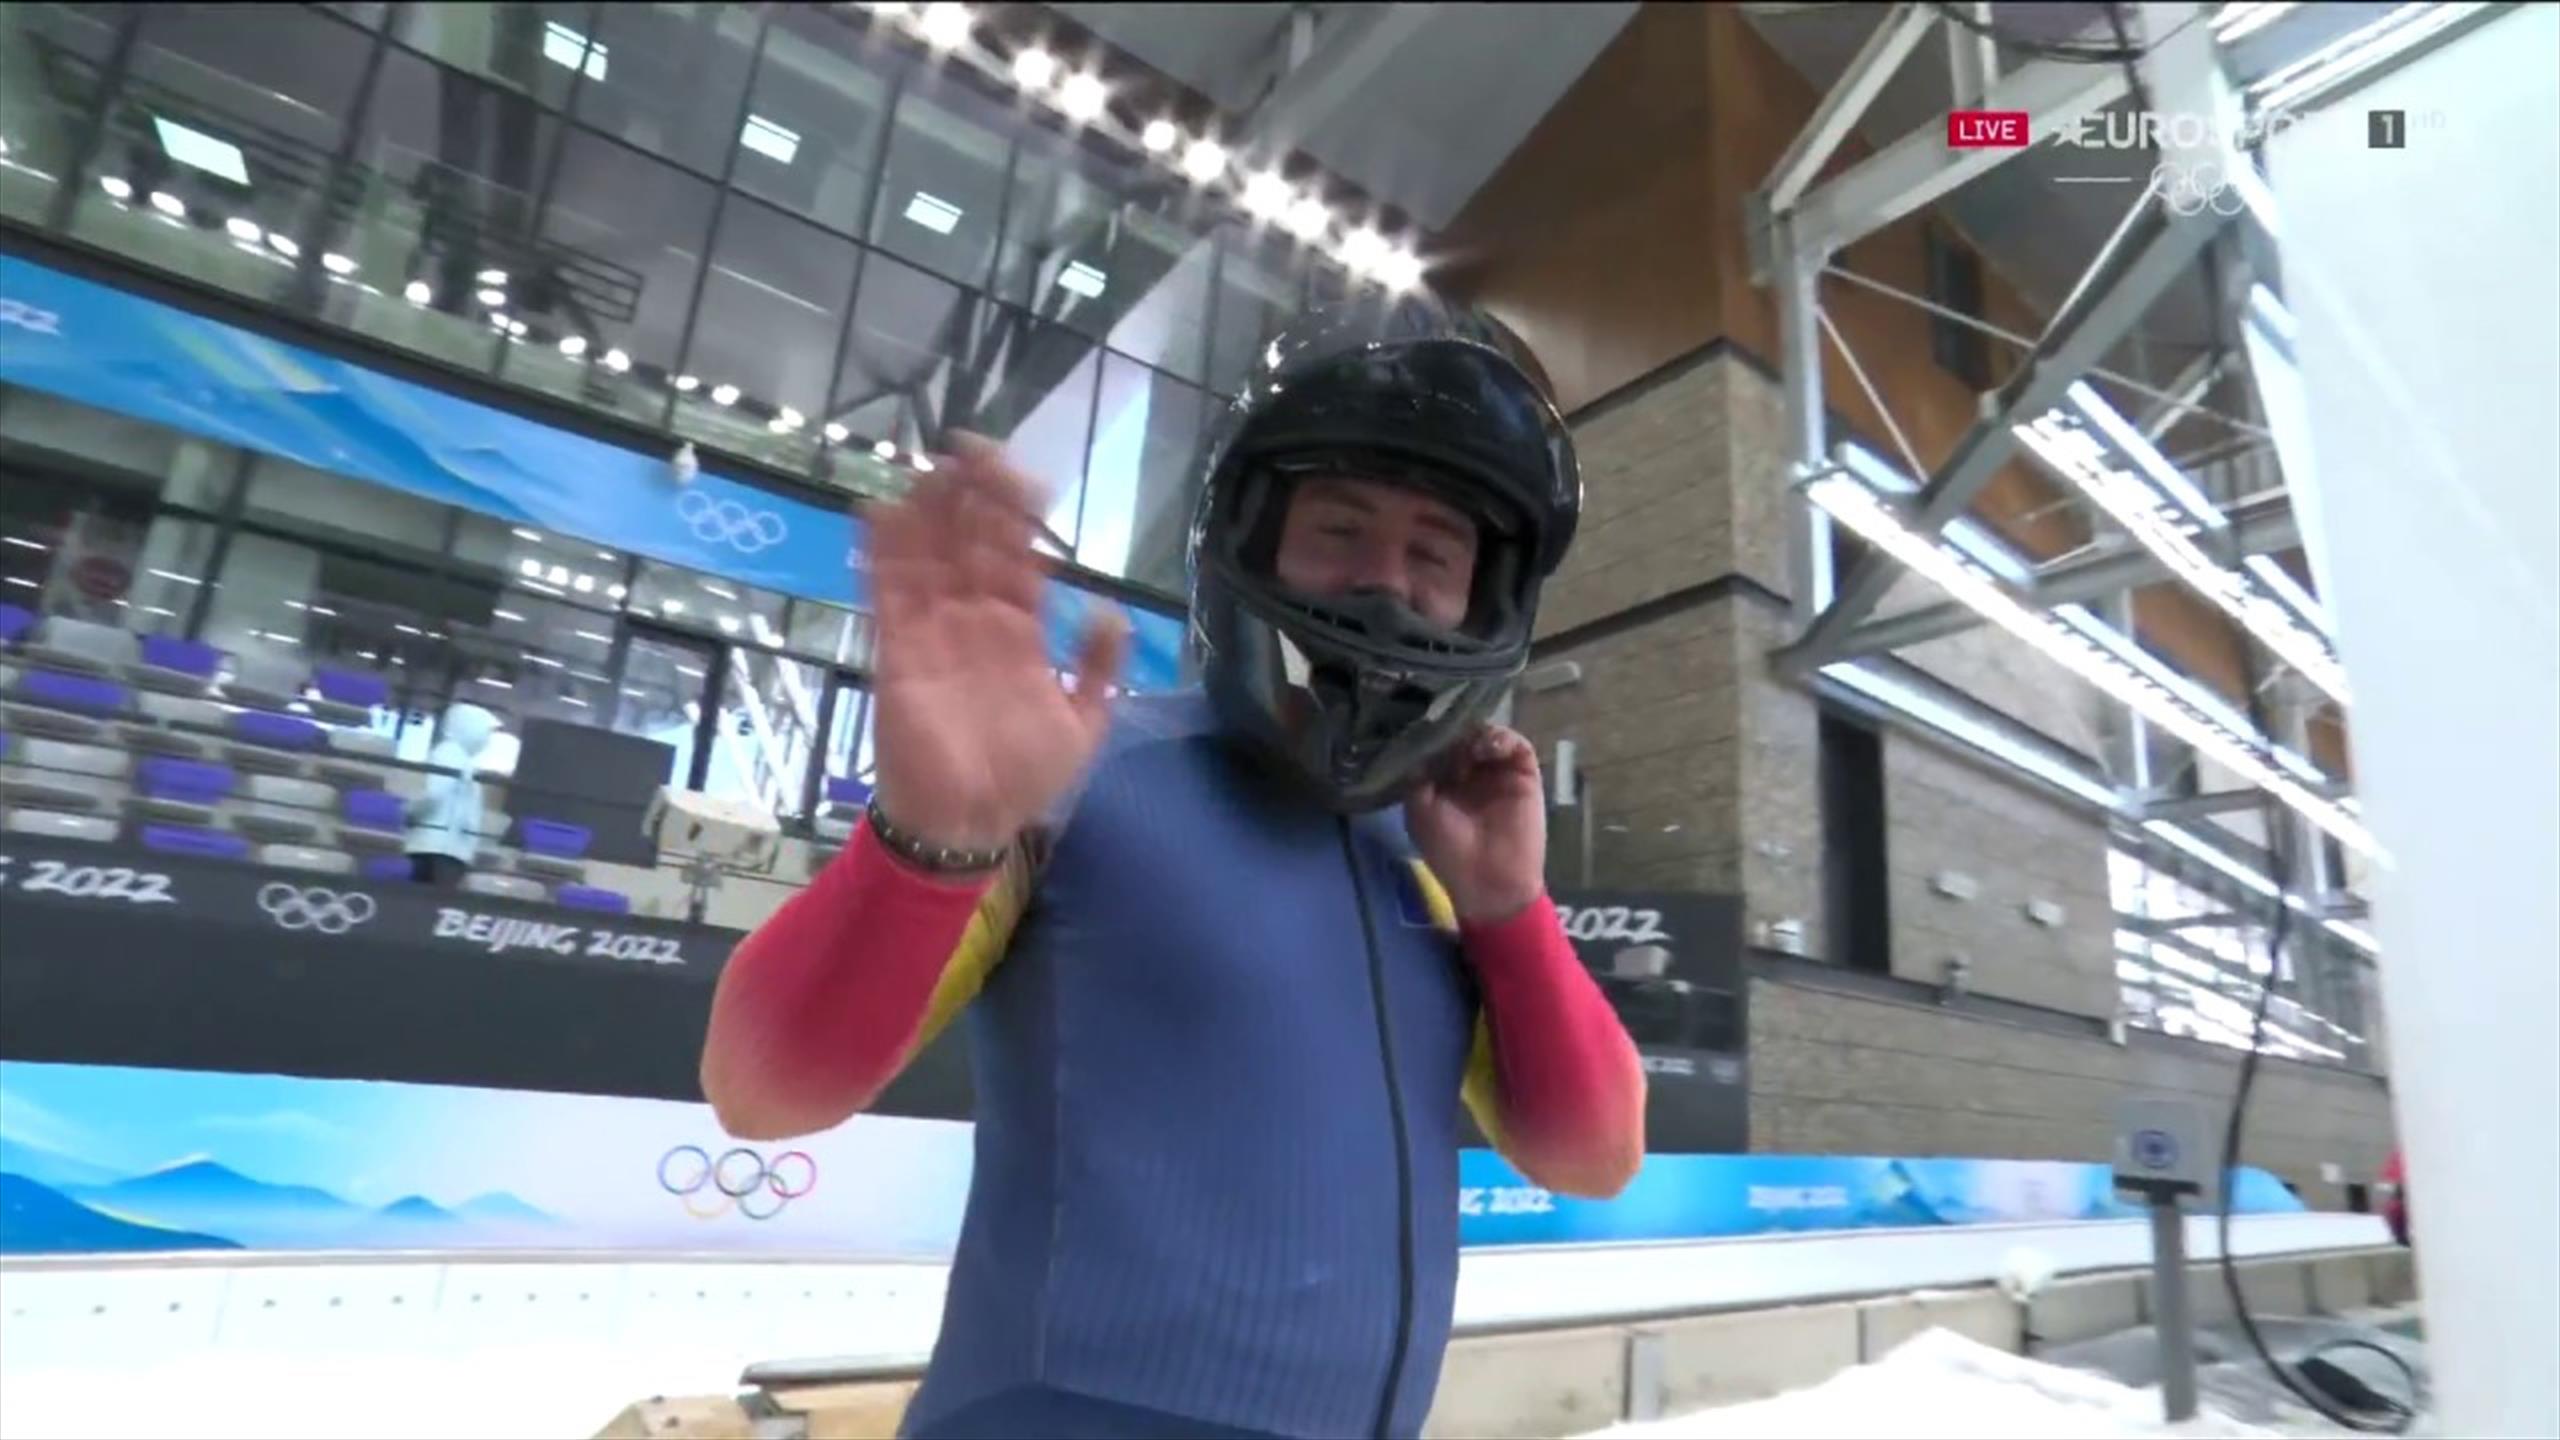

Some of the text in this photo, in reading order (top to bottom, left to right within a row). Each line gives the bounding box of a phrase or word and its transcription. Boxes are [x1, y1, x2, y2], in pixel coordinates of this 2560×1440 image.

[20, 860, 178, 903] 2022
[433, 907, 687, 964] BEIJING 2022
[1555, 905, 1672, 942] 2022
